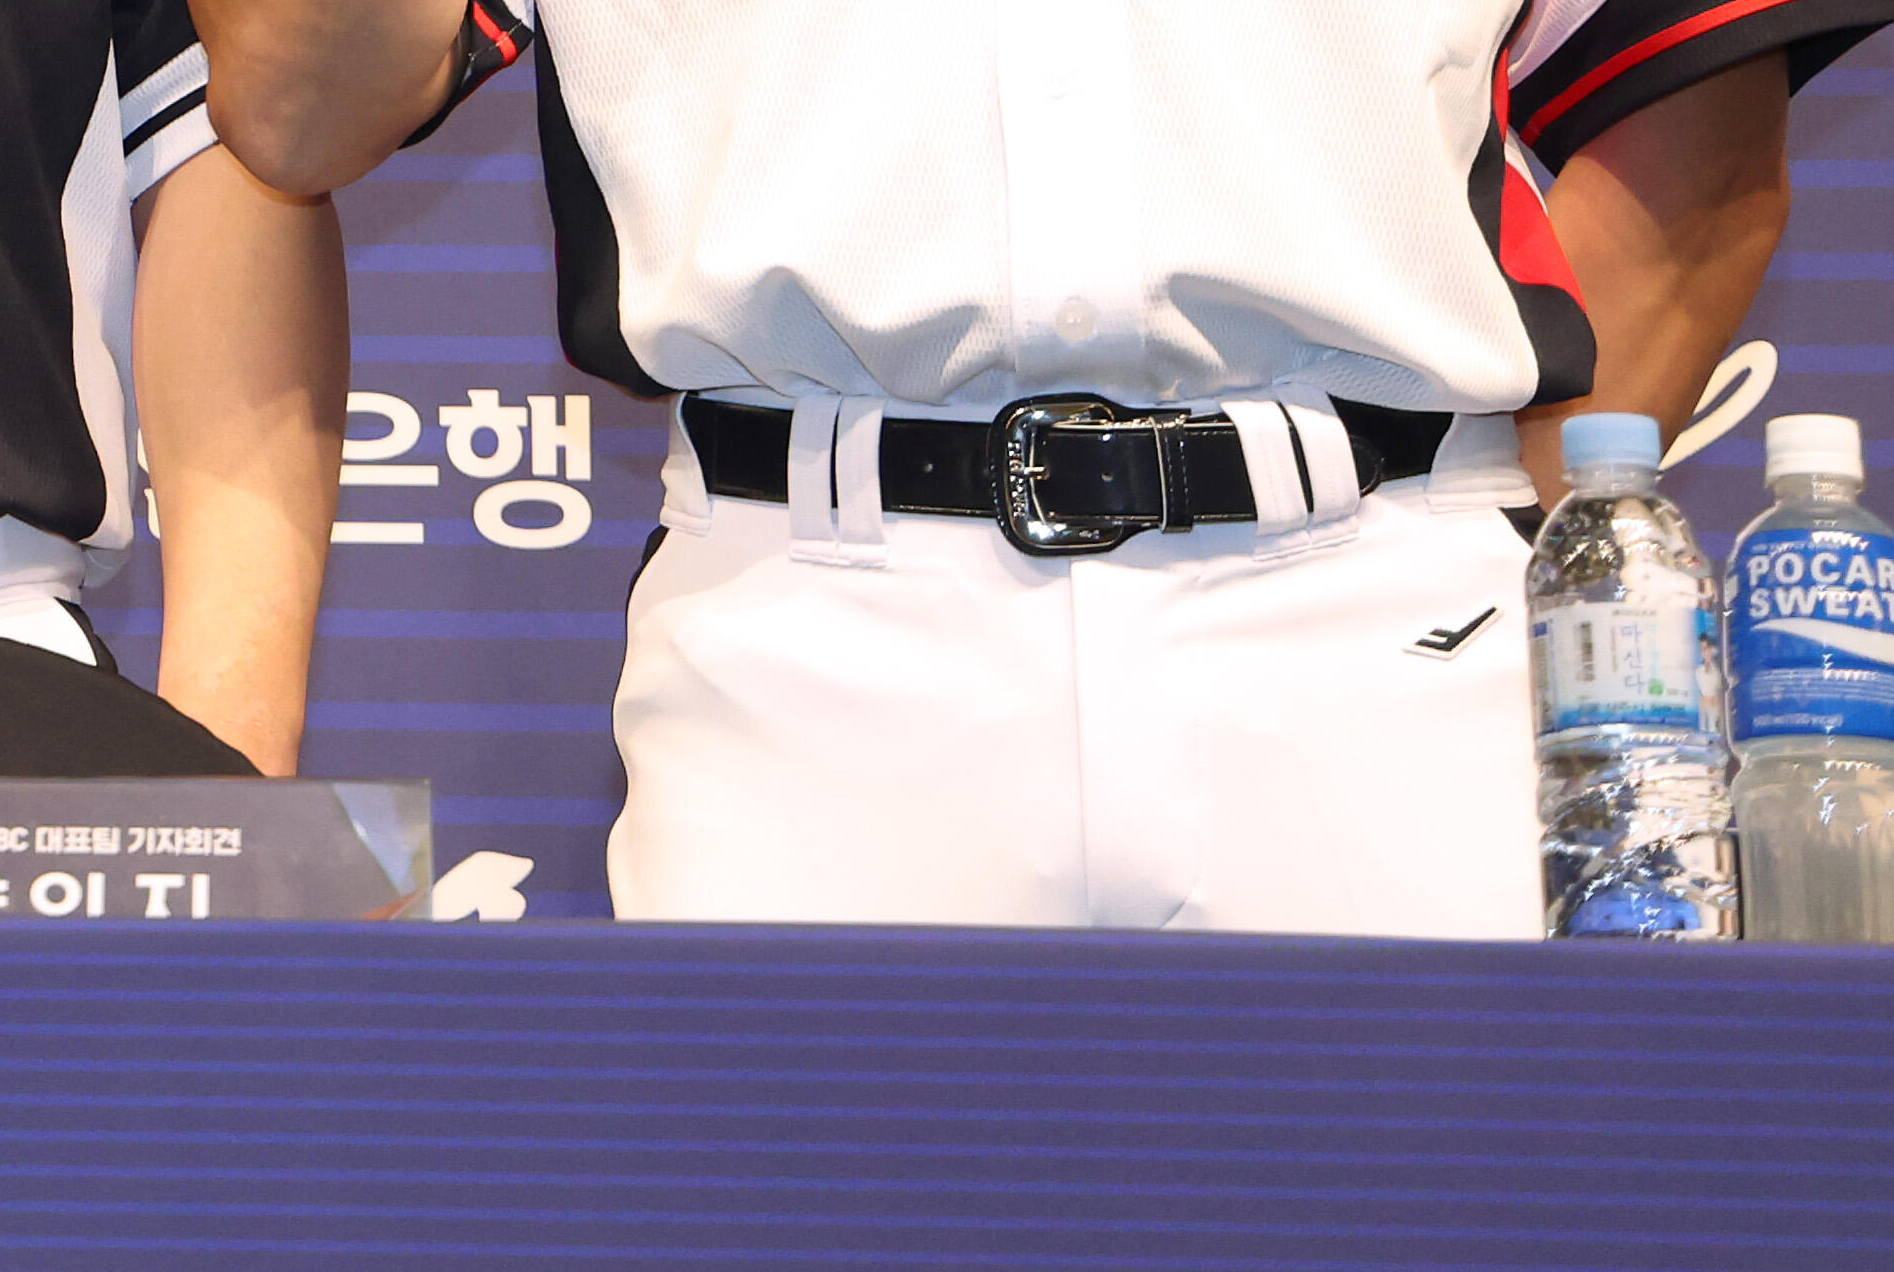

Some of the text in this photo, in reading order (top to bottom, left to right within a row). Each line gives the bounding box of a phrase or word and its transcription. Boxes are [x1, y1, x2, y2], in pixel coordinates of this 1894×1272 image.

[1748, 552, 1894, 590] POCAR
[35, 826, 121, 854] 대표팀
[127, 827, 242, 855] 기자회견
